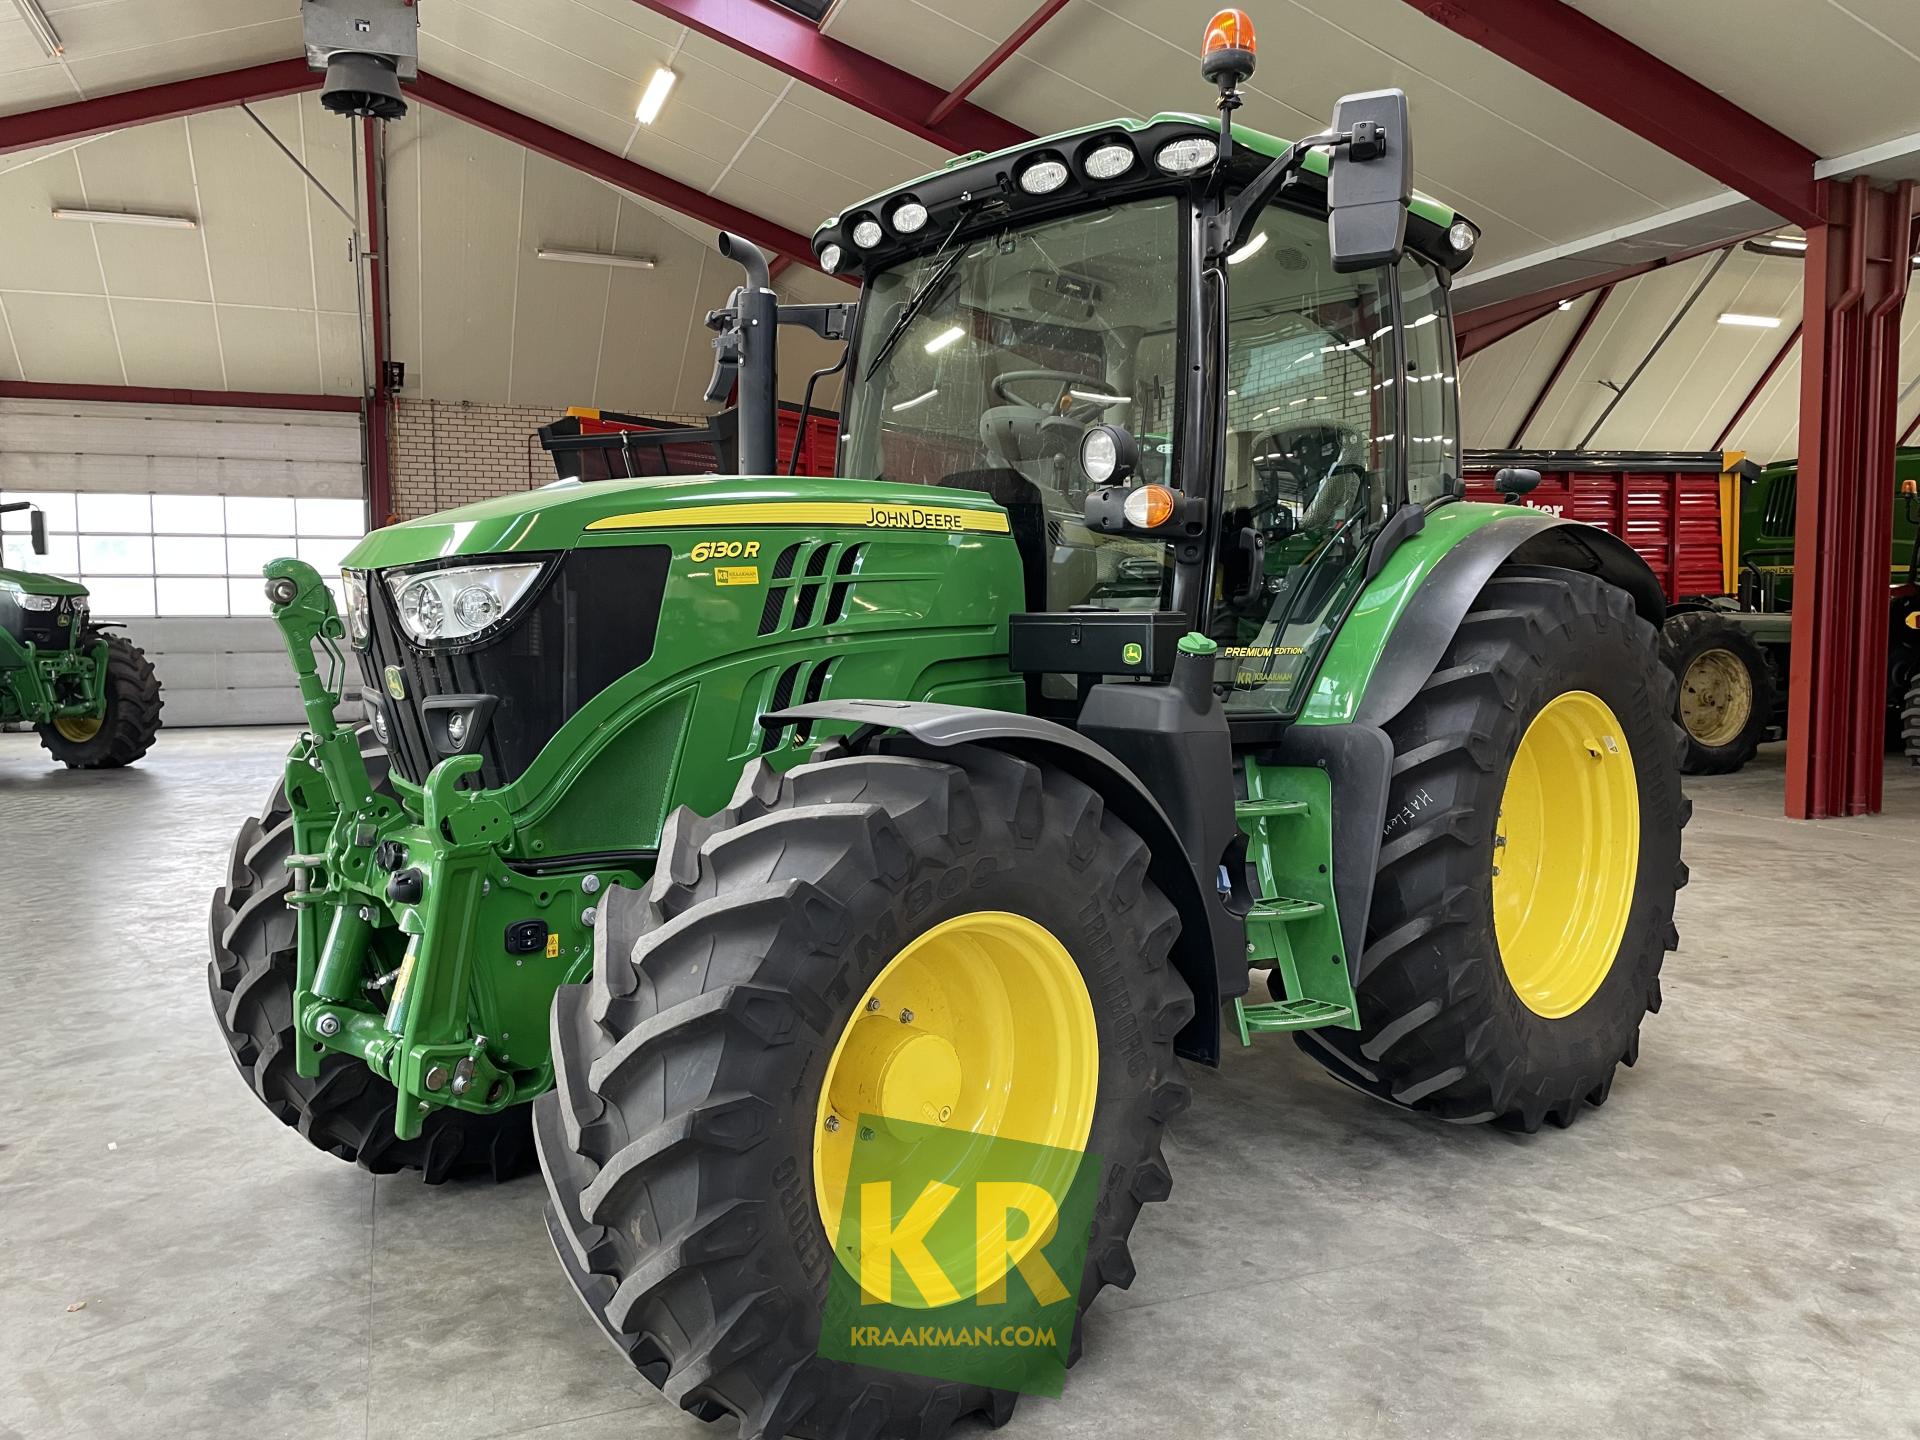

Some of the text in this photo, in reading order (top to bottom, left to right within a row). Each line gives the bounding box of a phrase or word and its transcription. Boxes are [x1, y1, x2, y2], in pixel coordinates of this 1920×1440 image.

[866, 508, 963, 528] JOHN DEERE
[1224, 646, 1305, 658] PREMIUM EDITION
